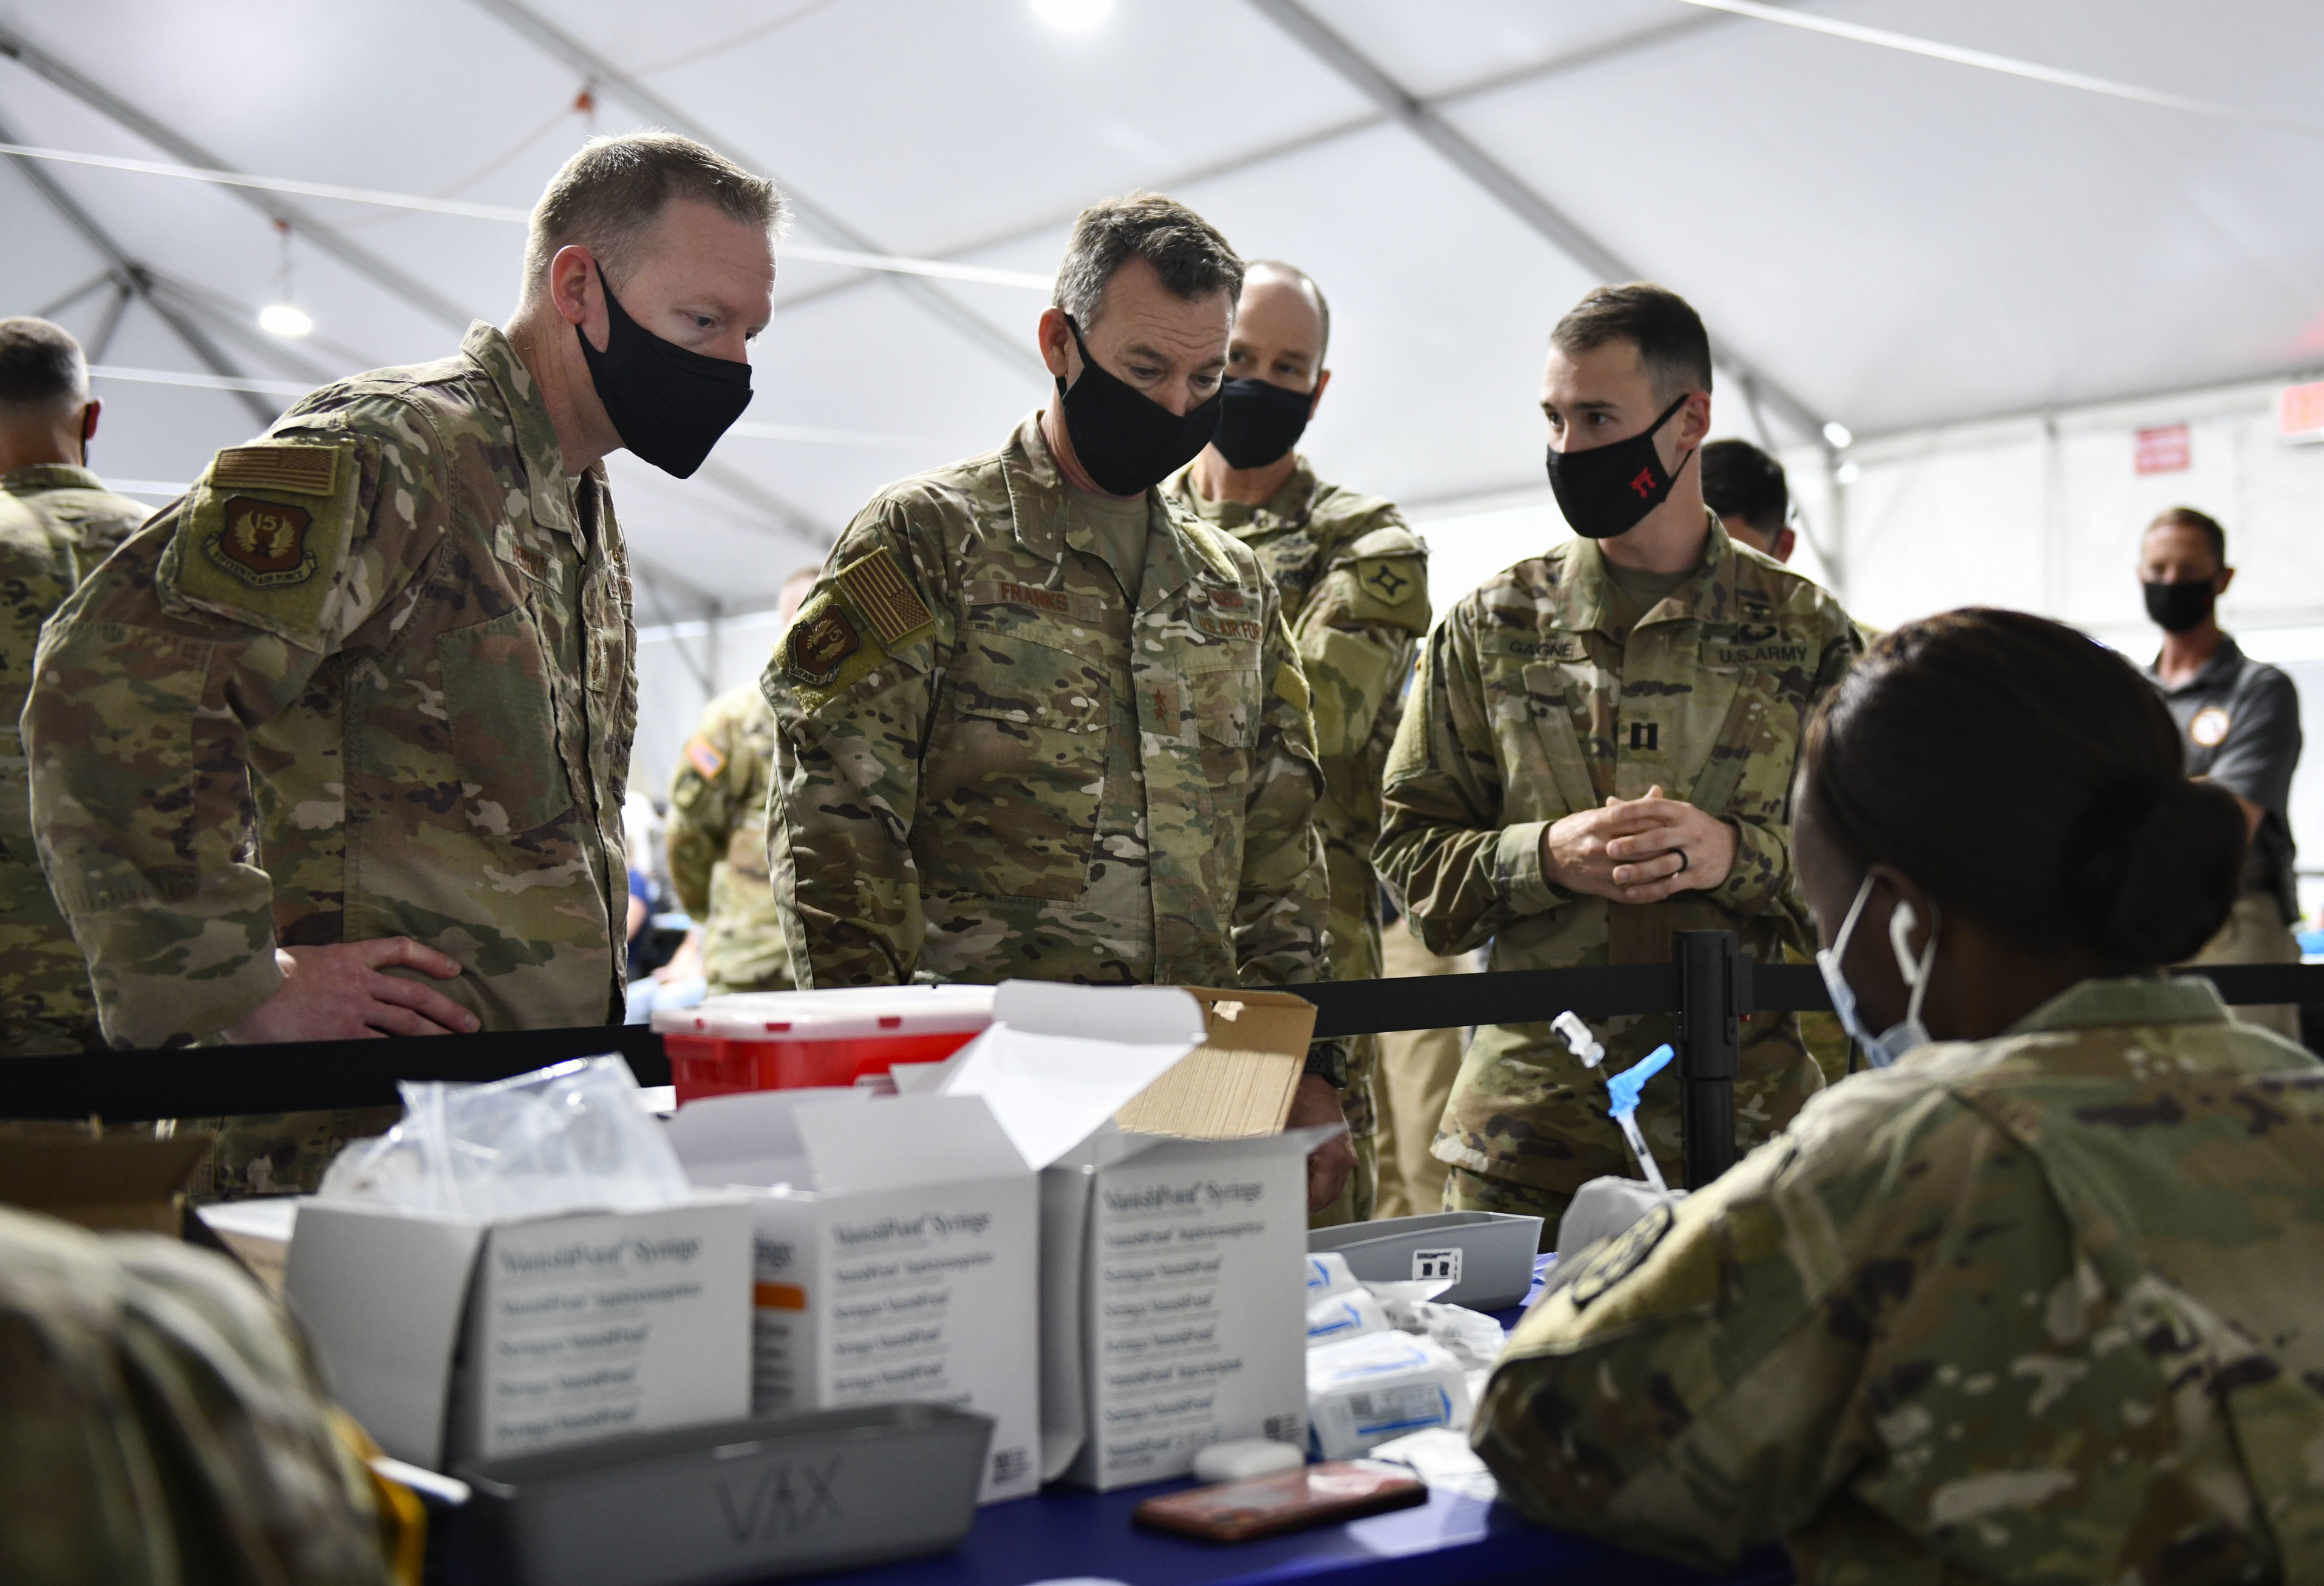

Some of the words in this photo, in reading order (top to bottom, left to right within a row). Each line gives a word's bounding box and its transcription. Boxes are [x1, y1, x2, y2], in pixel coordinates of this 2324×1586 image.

[256, 513, 277, 531] 15
[1001, 581, 1068, 613] FRANKS
[825, 624, 843, 642] 15
[1219, 621, 1241, 638] AIR
[1508, 640, 1573, 657] GAGNE
[715, 1454, 843, 1546] VAX
